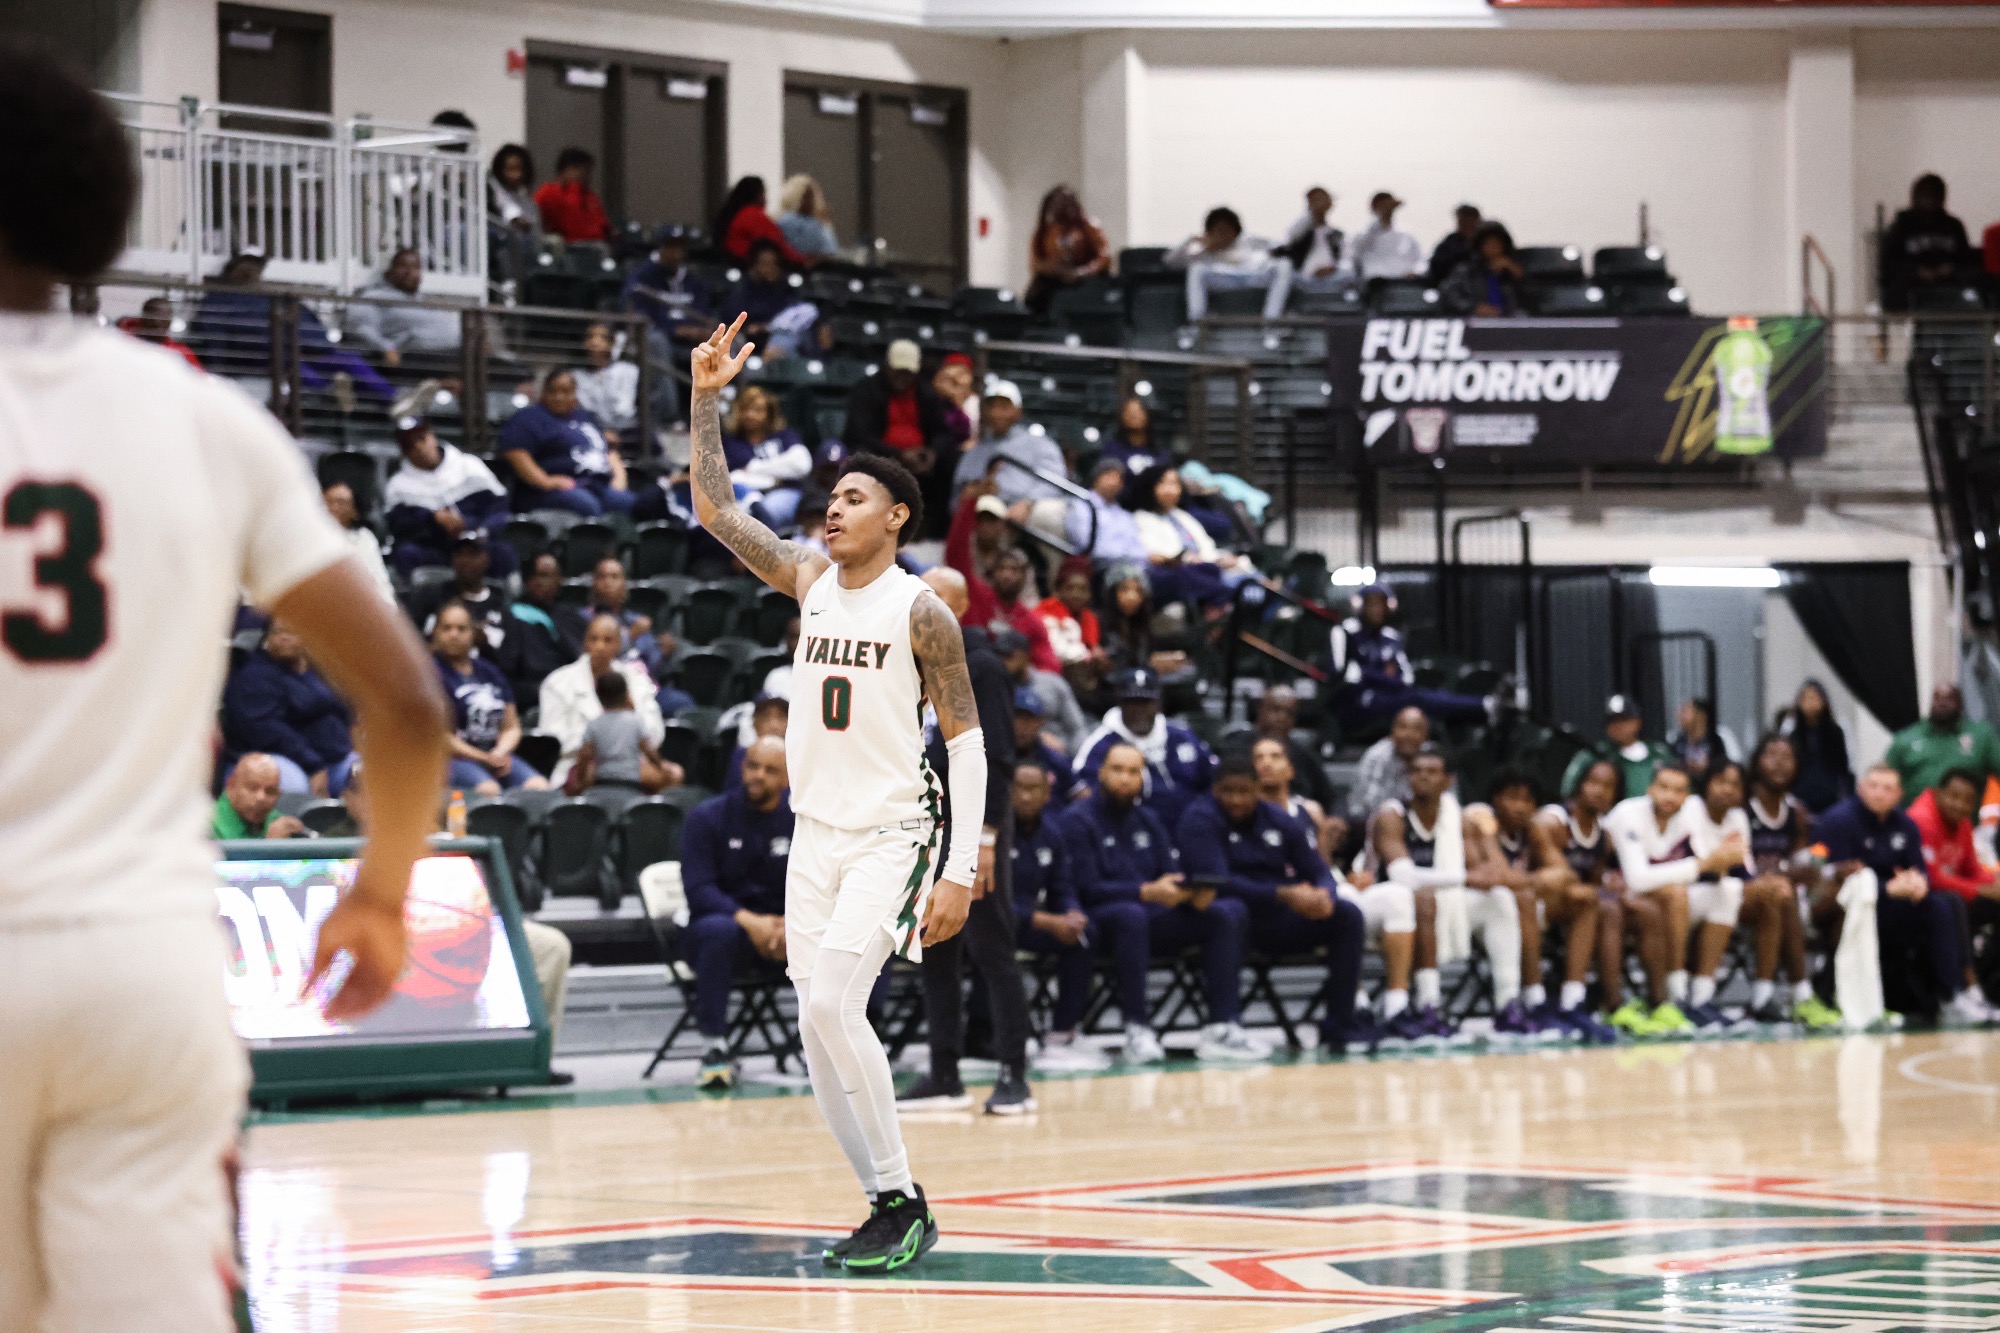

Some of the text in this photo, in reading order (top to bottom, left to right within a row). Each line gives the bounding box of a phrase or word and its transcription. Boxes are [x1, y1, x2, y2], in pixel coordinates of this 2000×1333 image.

[1361, 319, 1469, 359] FUEL
[1360, 361, 1621, 401] TOMORROW
[1, 479, 113, 663] 3
[805, 636, 891, 670] VALLEY
[822, 675, 852, 732] 0
